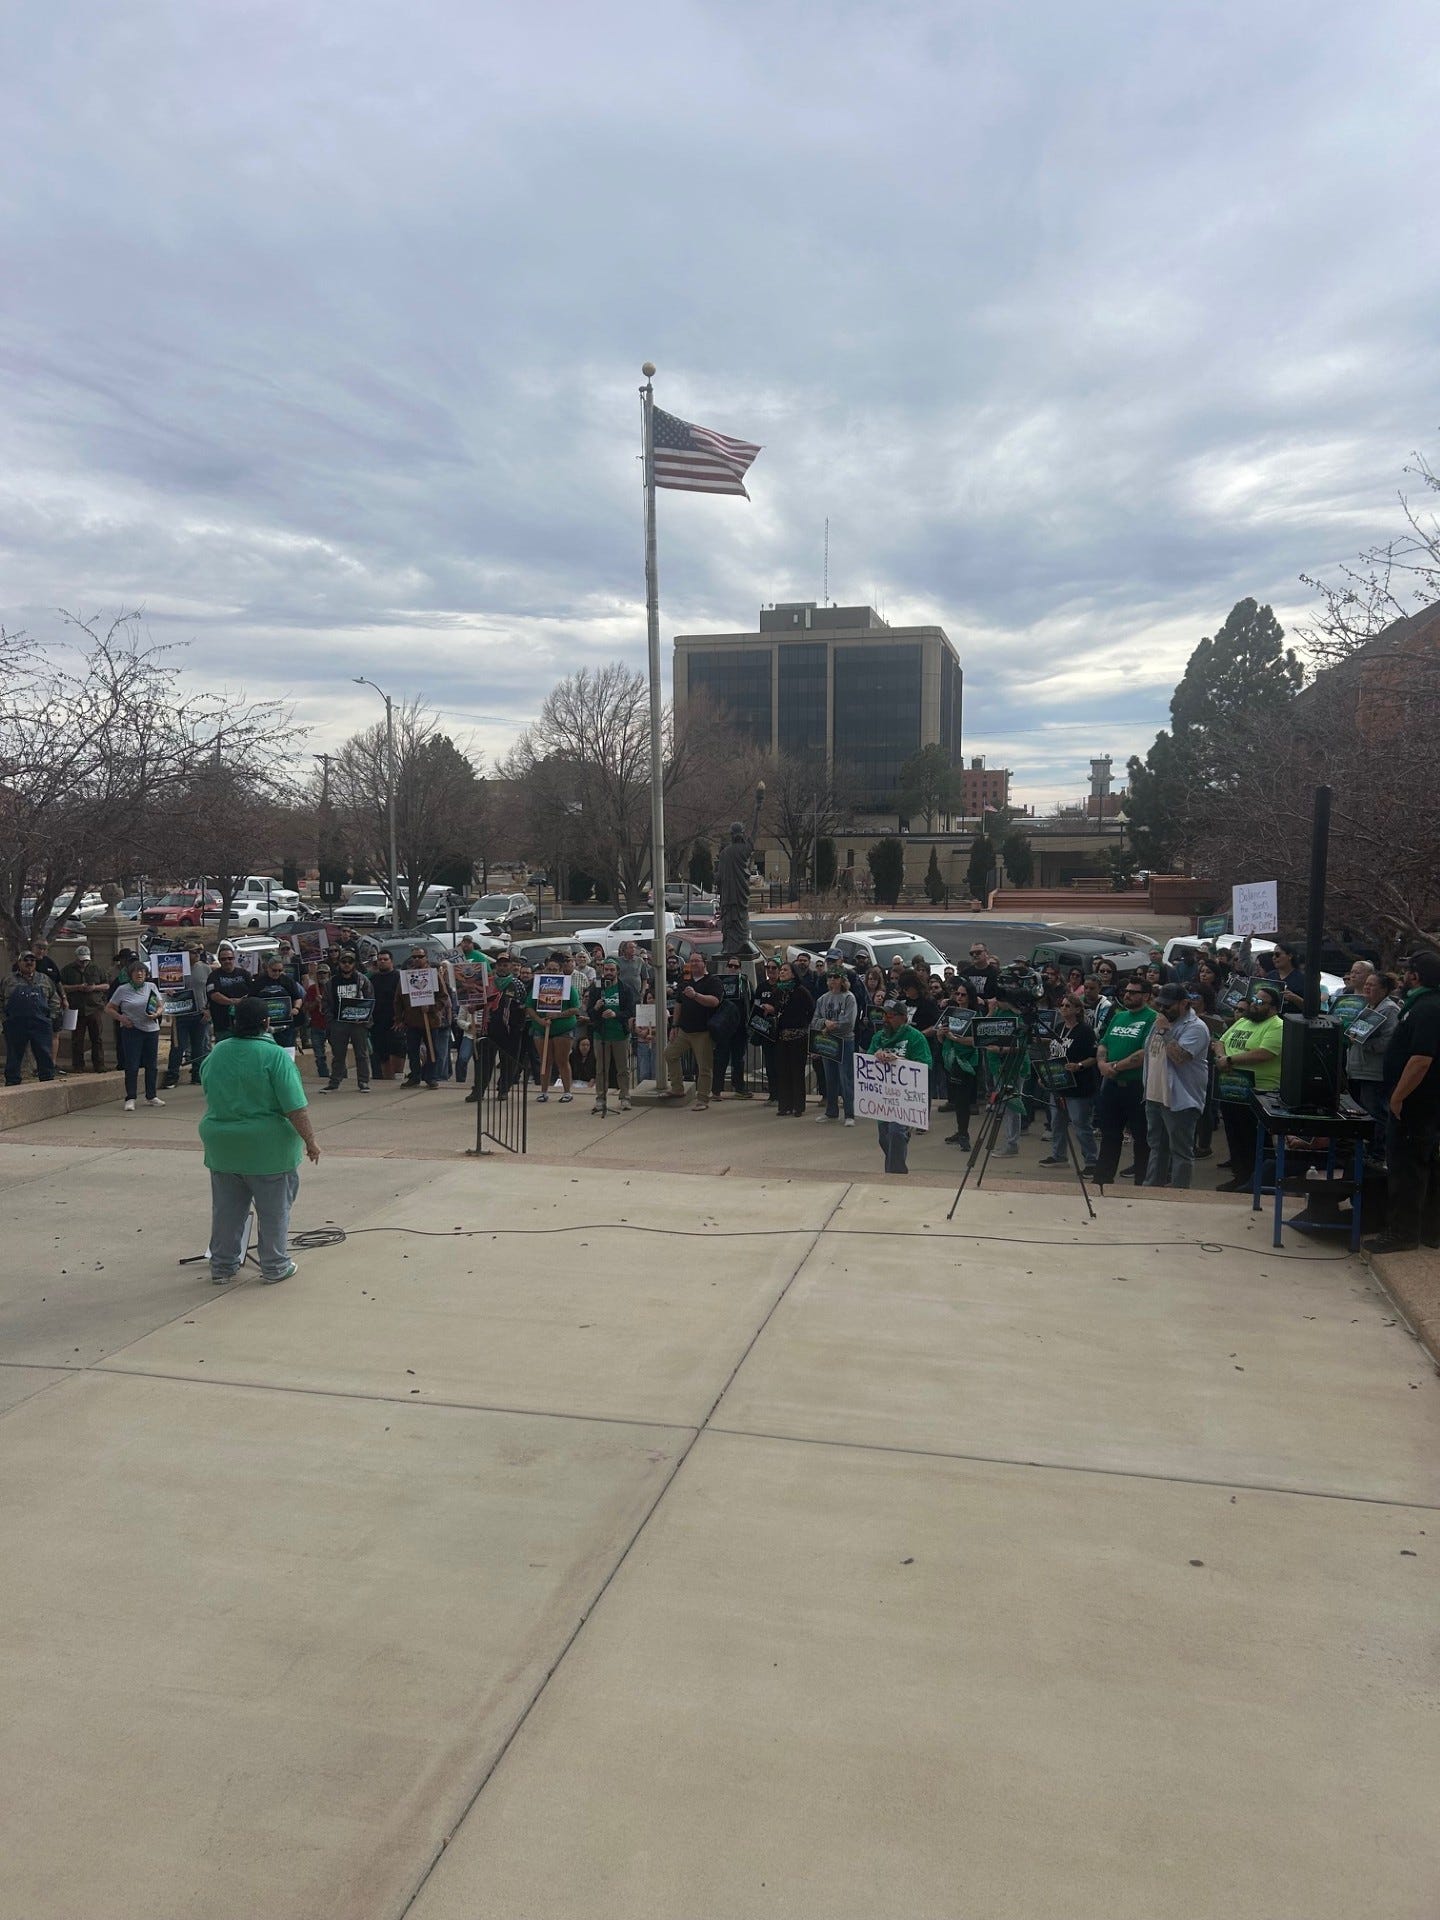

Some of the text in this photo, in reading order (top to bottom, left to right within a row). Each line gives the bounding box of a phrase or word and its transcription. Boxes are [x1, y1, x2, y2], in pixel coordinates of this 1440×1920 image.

[1111, 1026, 1142, 1036] AFSCME
[856, 1054, 921, 1088] RESPECT
[858, 1081, 926, 1104] THOSE WHO SERVE
[882, 1097, 900, 1107] THIS
[858, 1098, 928, 1126] COMMUNITY
